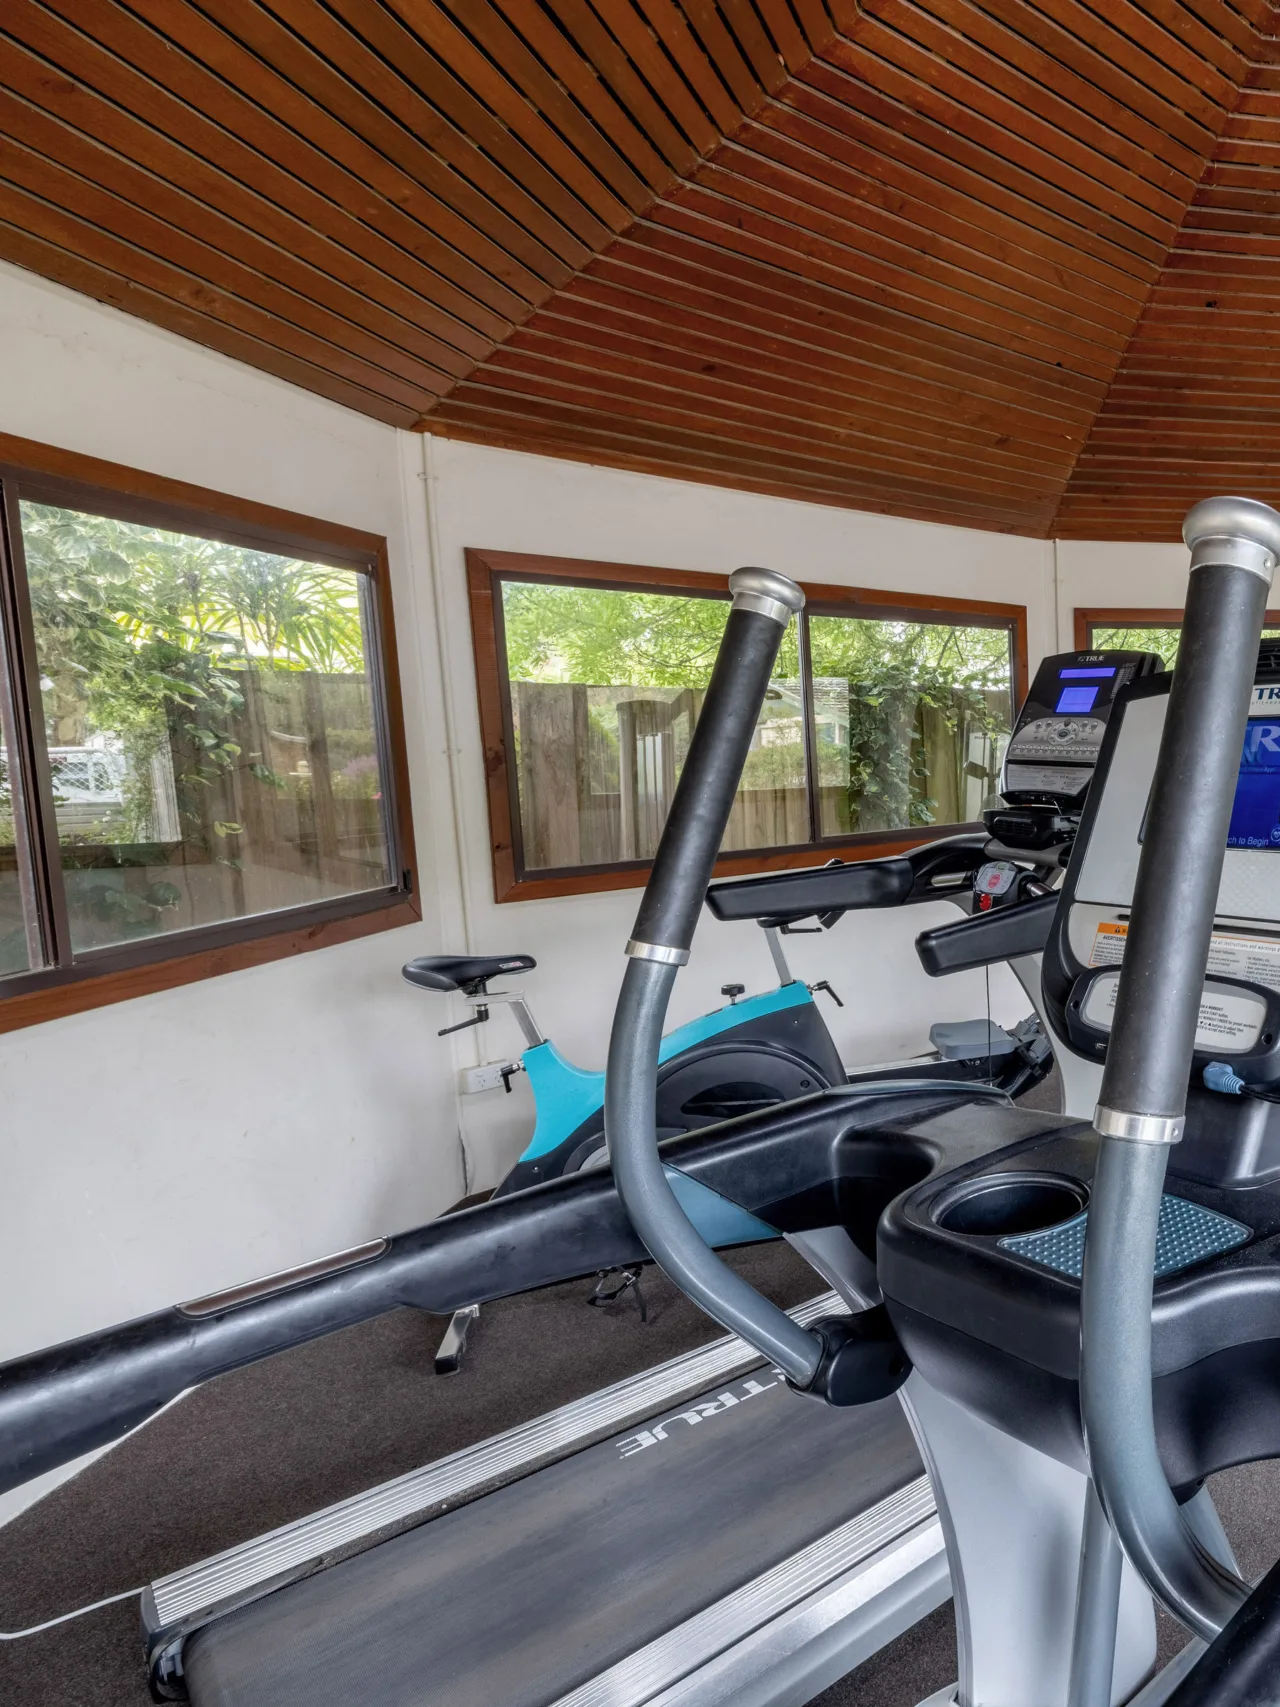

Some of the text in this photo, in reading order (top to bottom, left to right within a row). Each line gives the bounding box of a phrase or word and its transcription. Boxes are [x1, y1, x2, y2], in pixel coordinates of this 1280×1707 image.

[1238, 836, 1246, 845] to
[1247, 836, 1269, 848] Begin
[1224, 941, 1249, 949] instructions
[616, 1379, 778, 1458] TRUE
